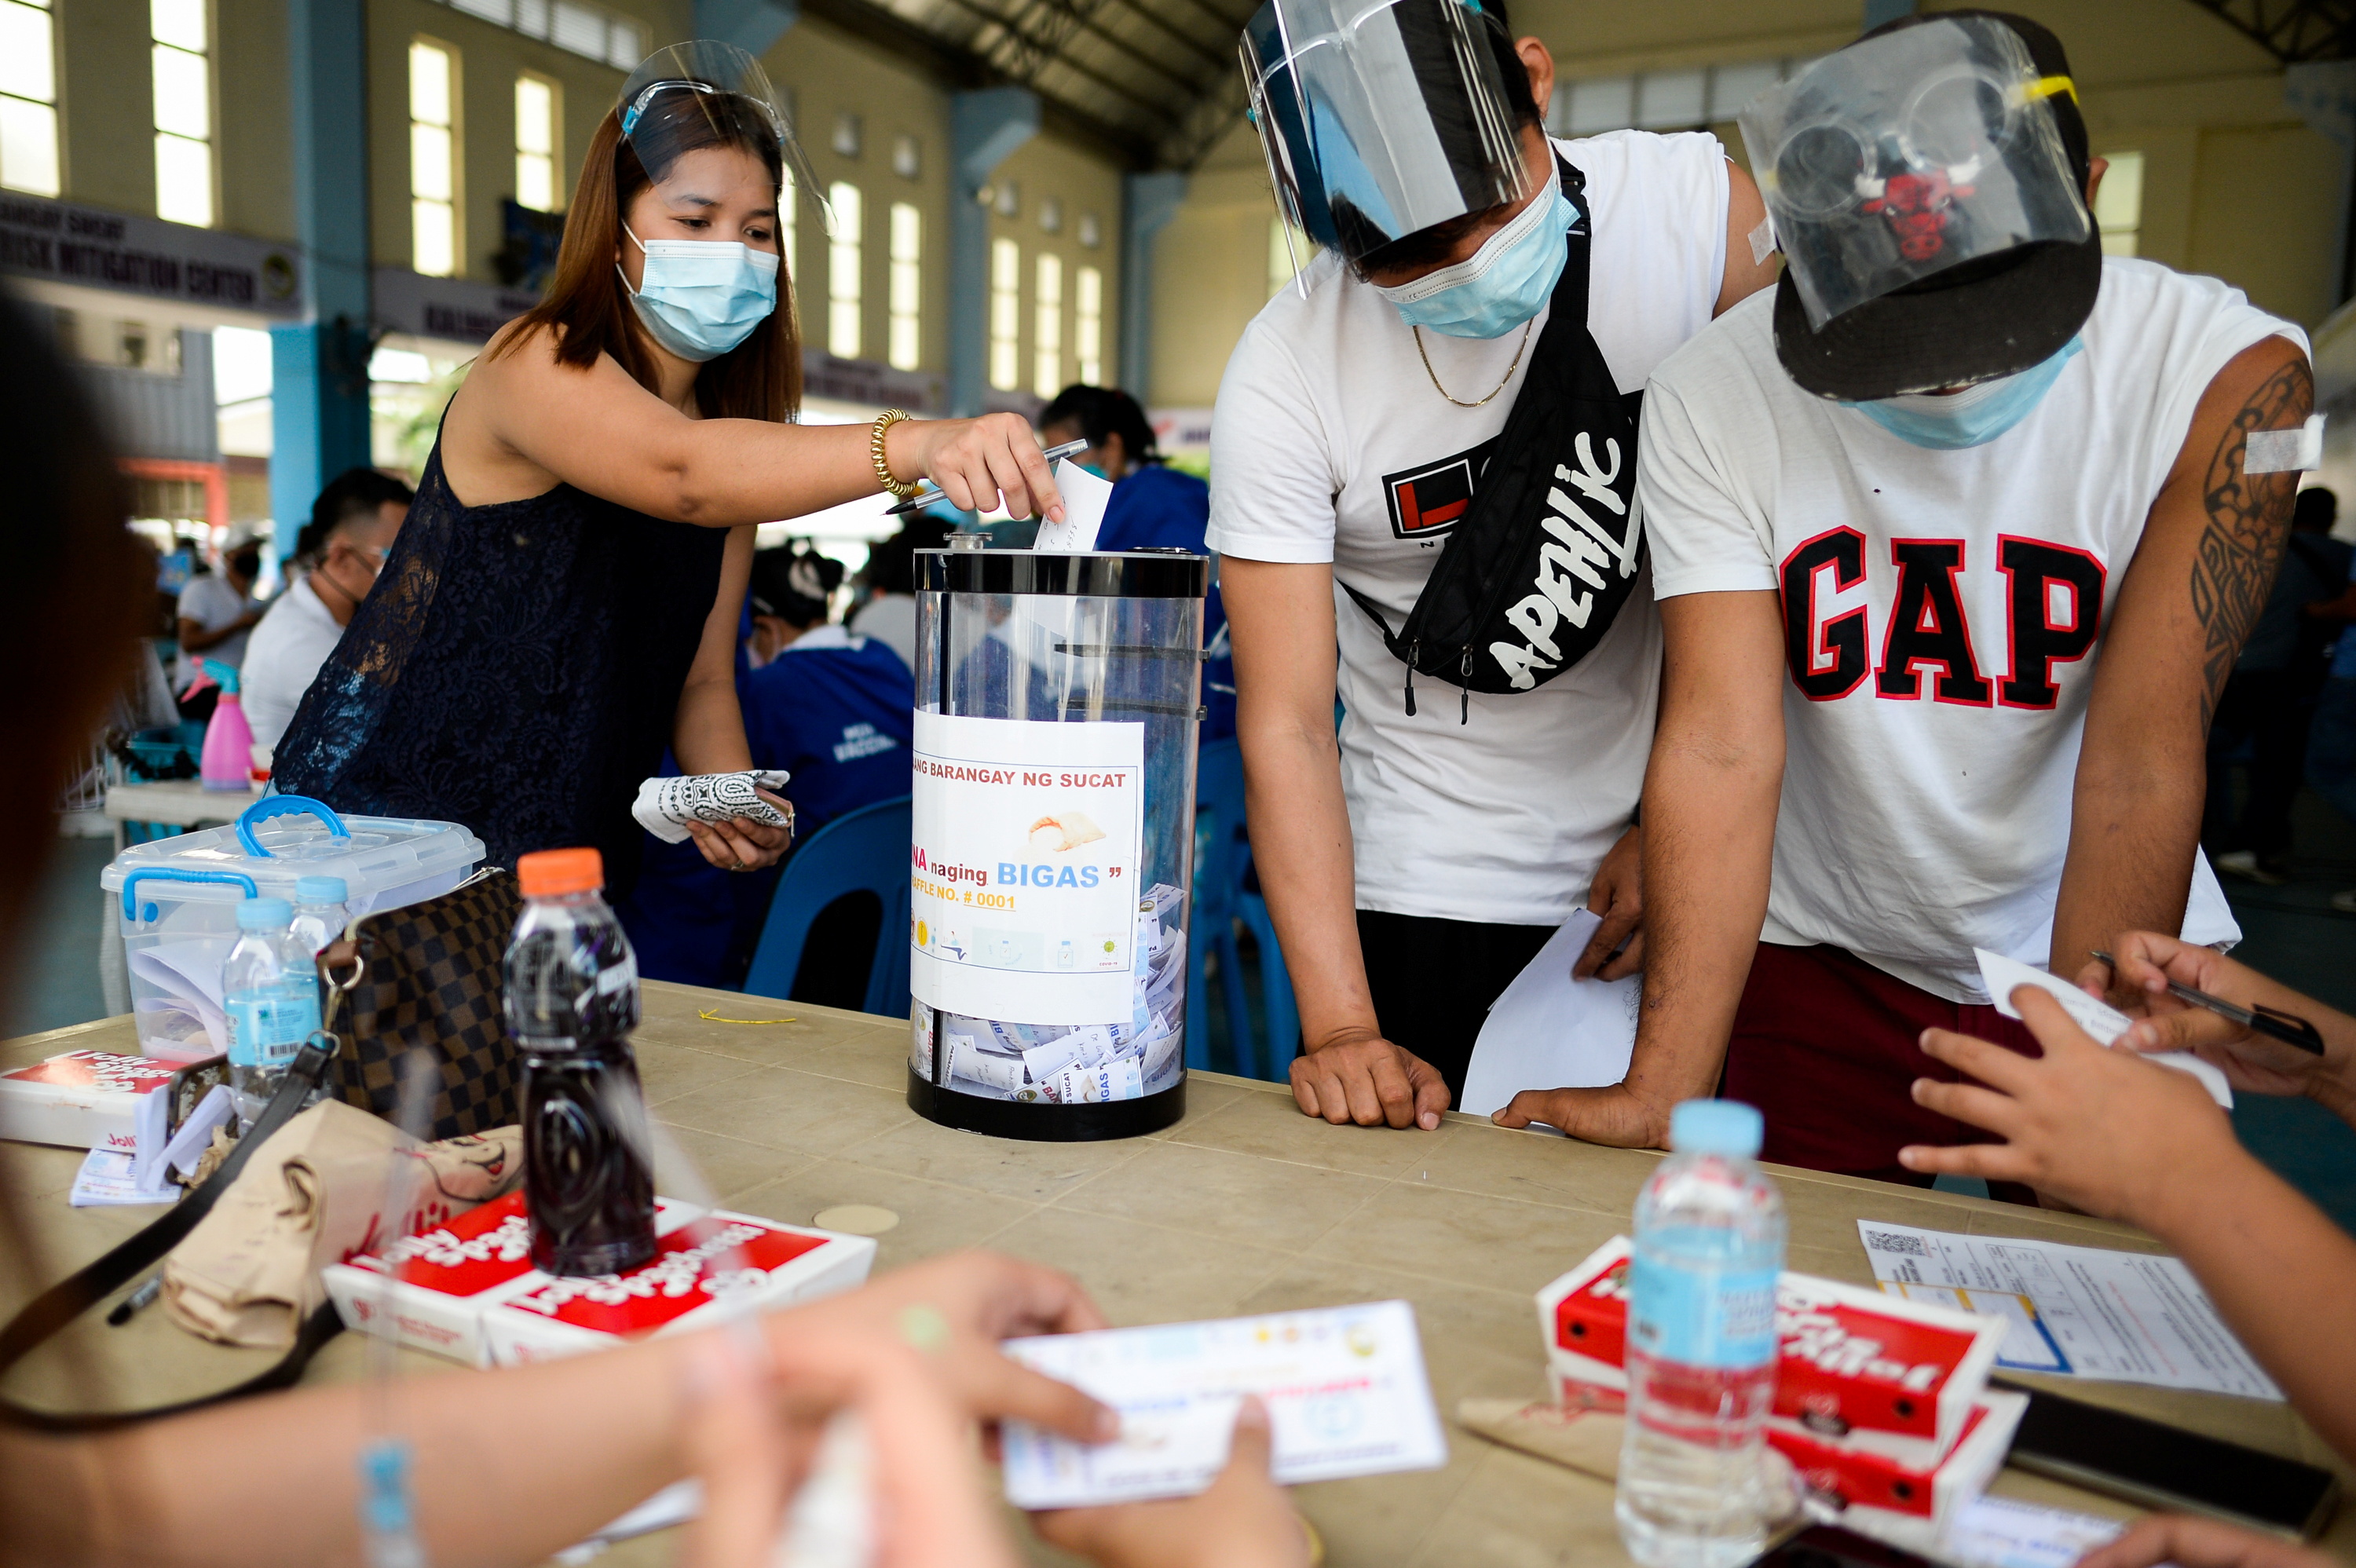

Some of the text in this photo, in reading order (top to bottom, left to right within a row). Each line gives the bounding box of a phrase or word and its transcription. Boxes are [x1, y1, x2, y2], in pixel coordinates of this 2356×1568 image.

[1780, 524, 2108, 711] GAP
[913, 758, 1126, 788] ANG BARANGAY NG SUCAT
[931, 861, 988, 887] naging
[997, 862, 1099, 888] BIGAS
[937, 885, 960, 902] NO.
[976, 892, 1015, 909] 0001
